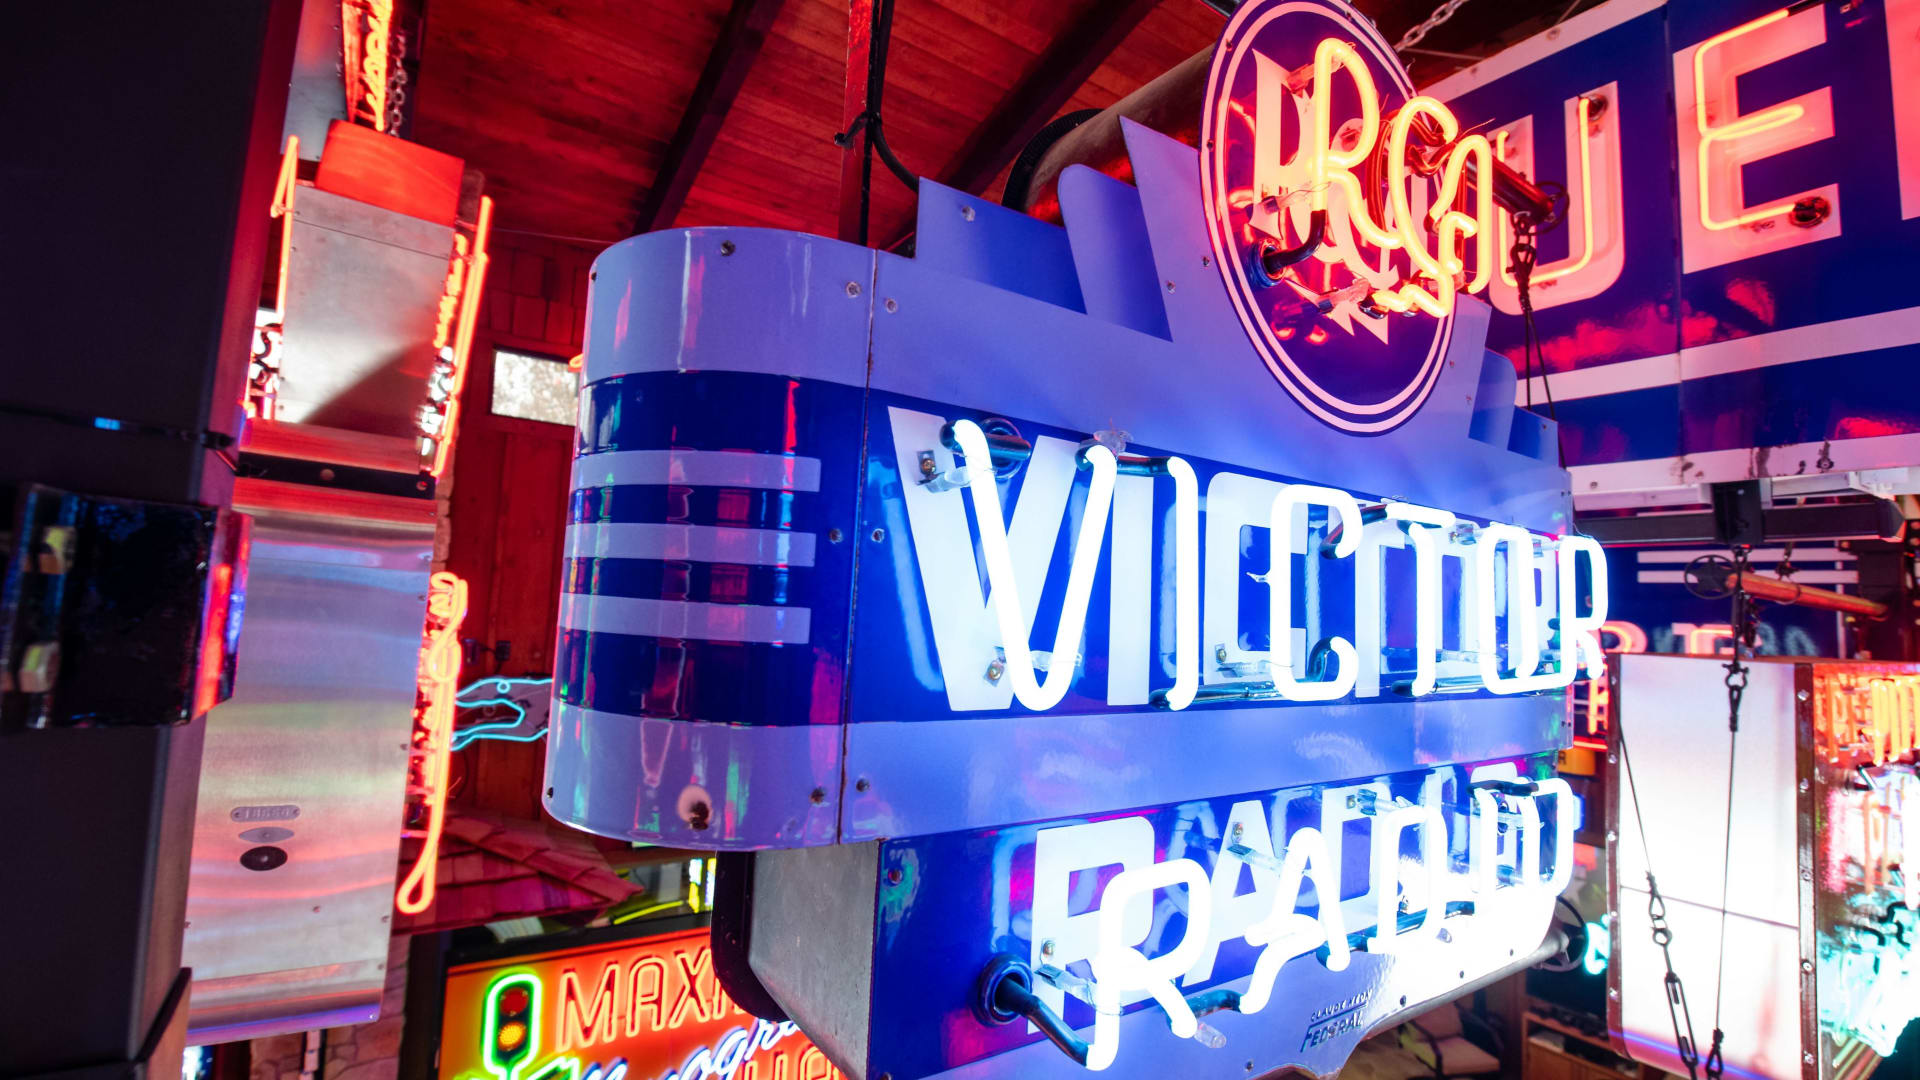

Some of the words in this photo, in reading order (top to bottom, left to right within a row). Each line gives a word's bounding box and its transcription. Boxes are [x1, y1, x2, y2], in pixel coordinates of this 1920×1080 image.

[1249, 37, 1494, 344] RCA
[888, 407, 1609, 712] VICTOR
[1028, 762, 1575, 1072] RADIO
[1300, 1010, 1363, 1053] FEDERAL
